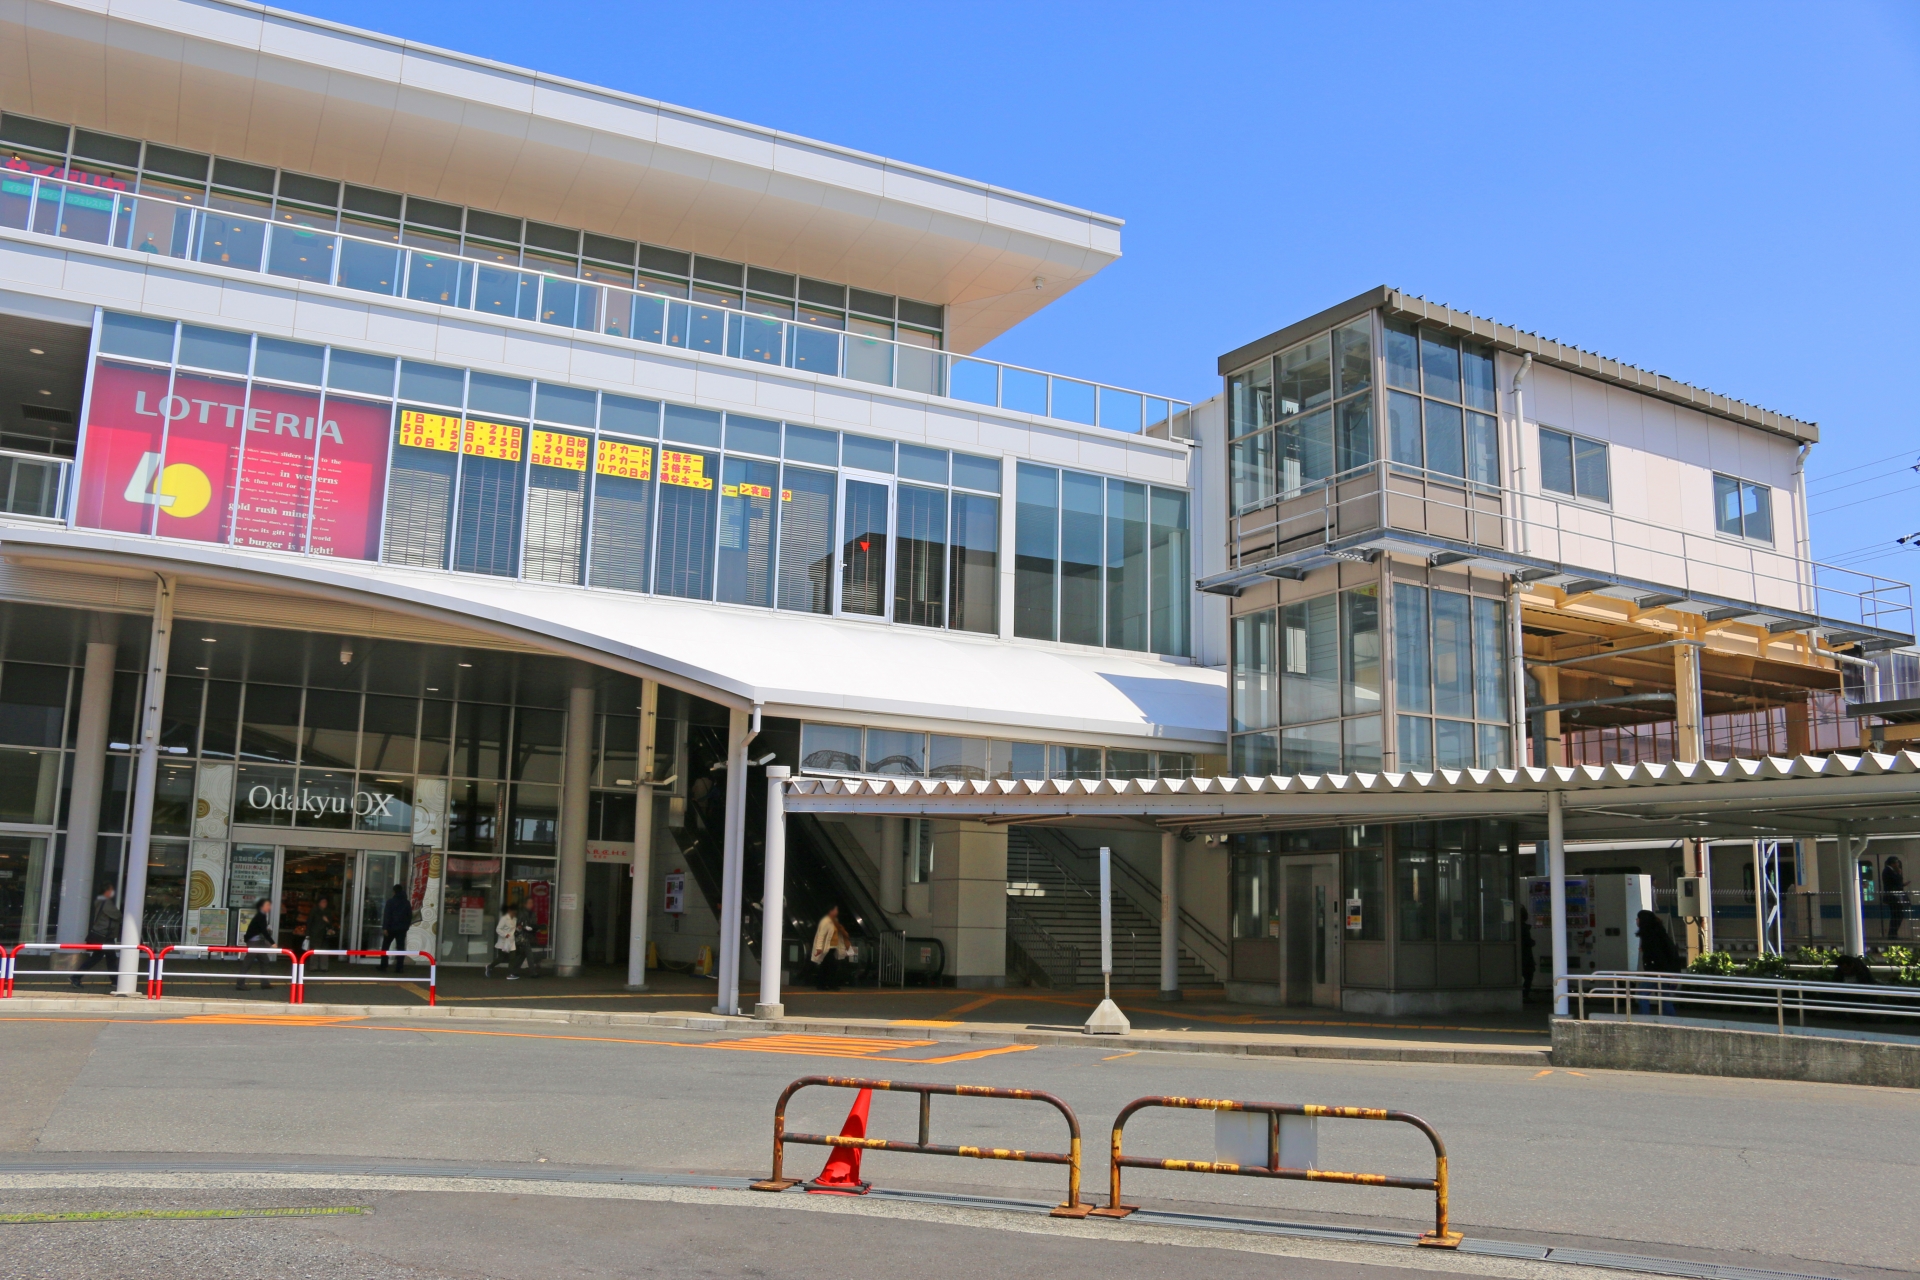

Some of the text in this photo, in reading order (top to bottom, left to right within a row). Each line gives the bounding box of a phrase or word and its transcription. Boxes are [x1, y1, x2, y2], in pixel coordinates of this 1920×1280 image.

[135, 390, 344, 445] LOTTERIA
[280, 469, 290, 478] in
[295, 473, 339, 485] weserns
[255, 506, 278, 515] rush
[282, 509, 317, 520] mines
[271, 529, 285, 537] gift
[248, 536, 283, 549] burger
[287, 542, 296, 550] is
[248, 785, 395, 819] Odakyu OX
